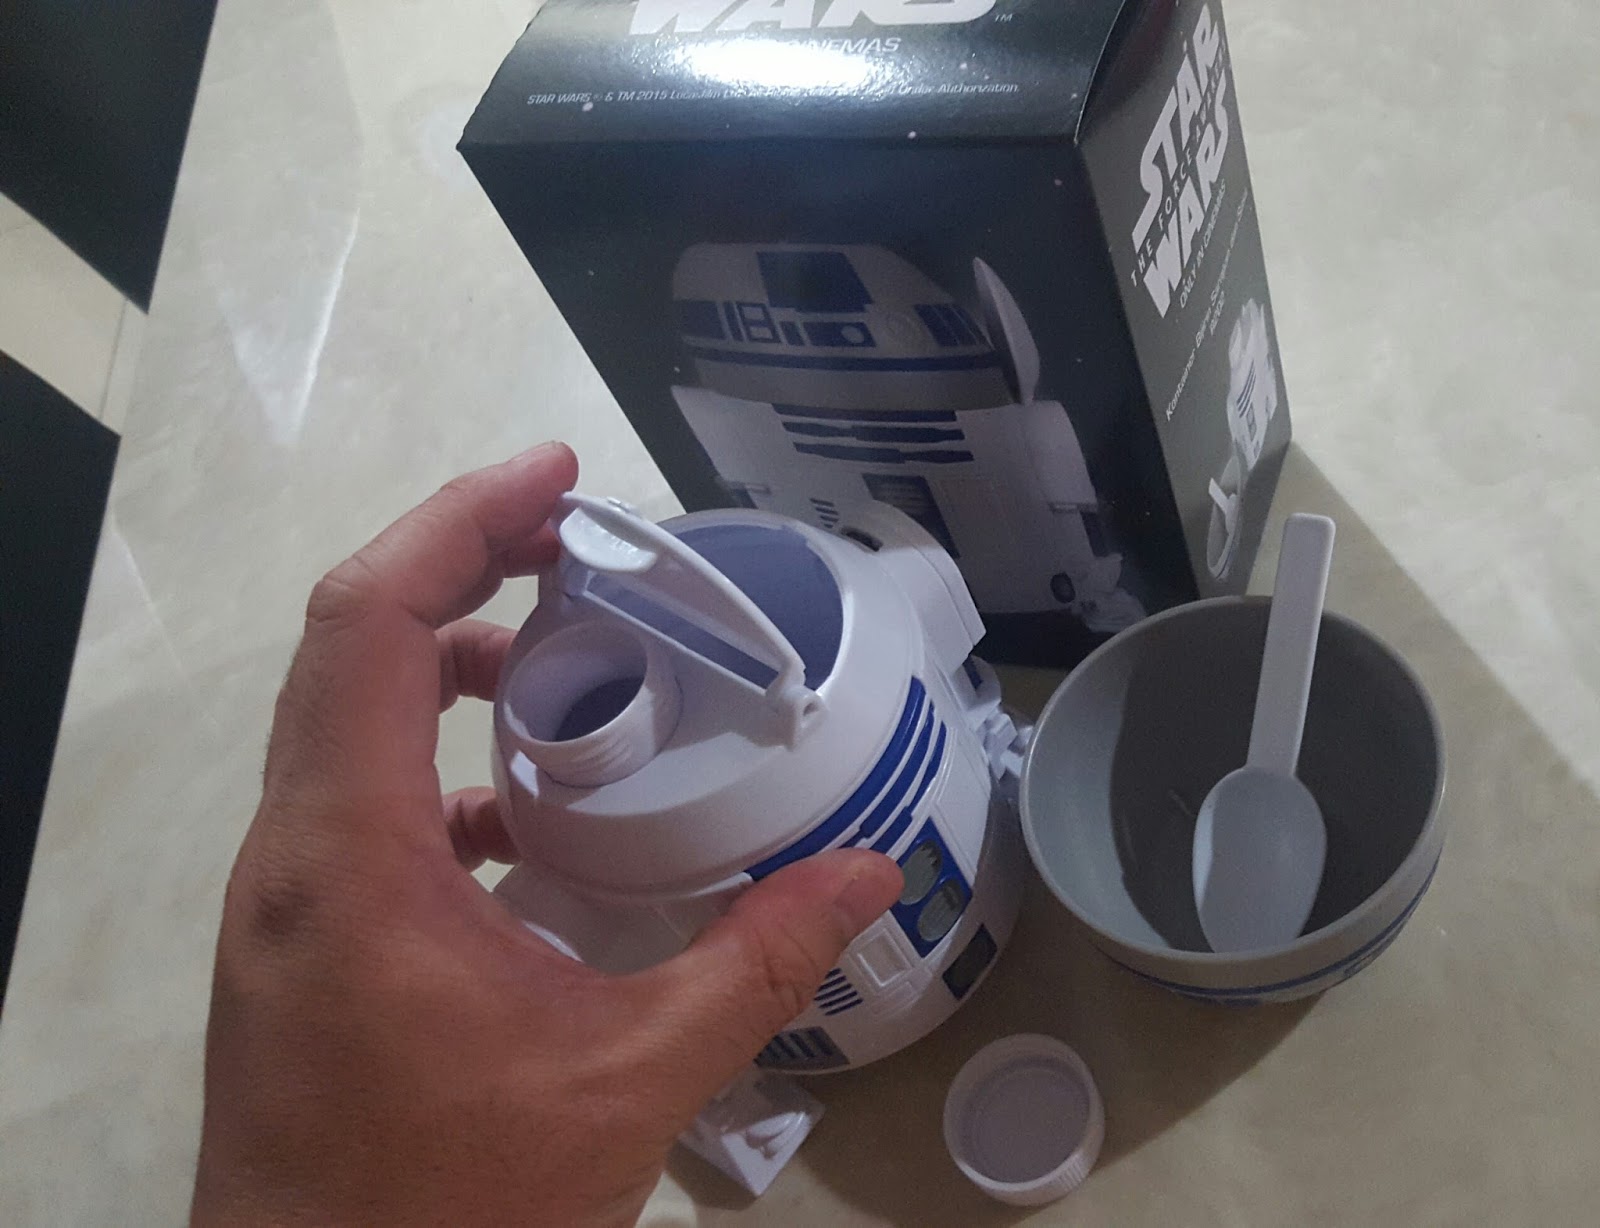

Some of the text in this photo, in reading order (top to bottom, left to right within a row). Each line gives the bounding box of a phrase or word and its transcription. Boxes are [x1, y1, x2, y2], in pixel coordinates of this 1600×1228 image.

[527, 93, 556, 105] STAR
[605, 91, 614, 102] &
[617, 91, 636, 101] TM
[636, 90, 667, 101] 2015
[1132, 2, 1220, 253] STAR
[1131, 239, 1153, 287] THE
[1158, 148, 1193, 232] FORCE
[1143, 67, 1229, 318] WARS
[1180, 268, 1197, 309] ONLY
